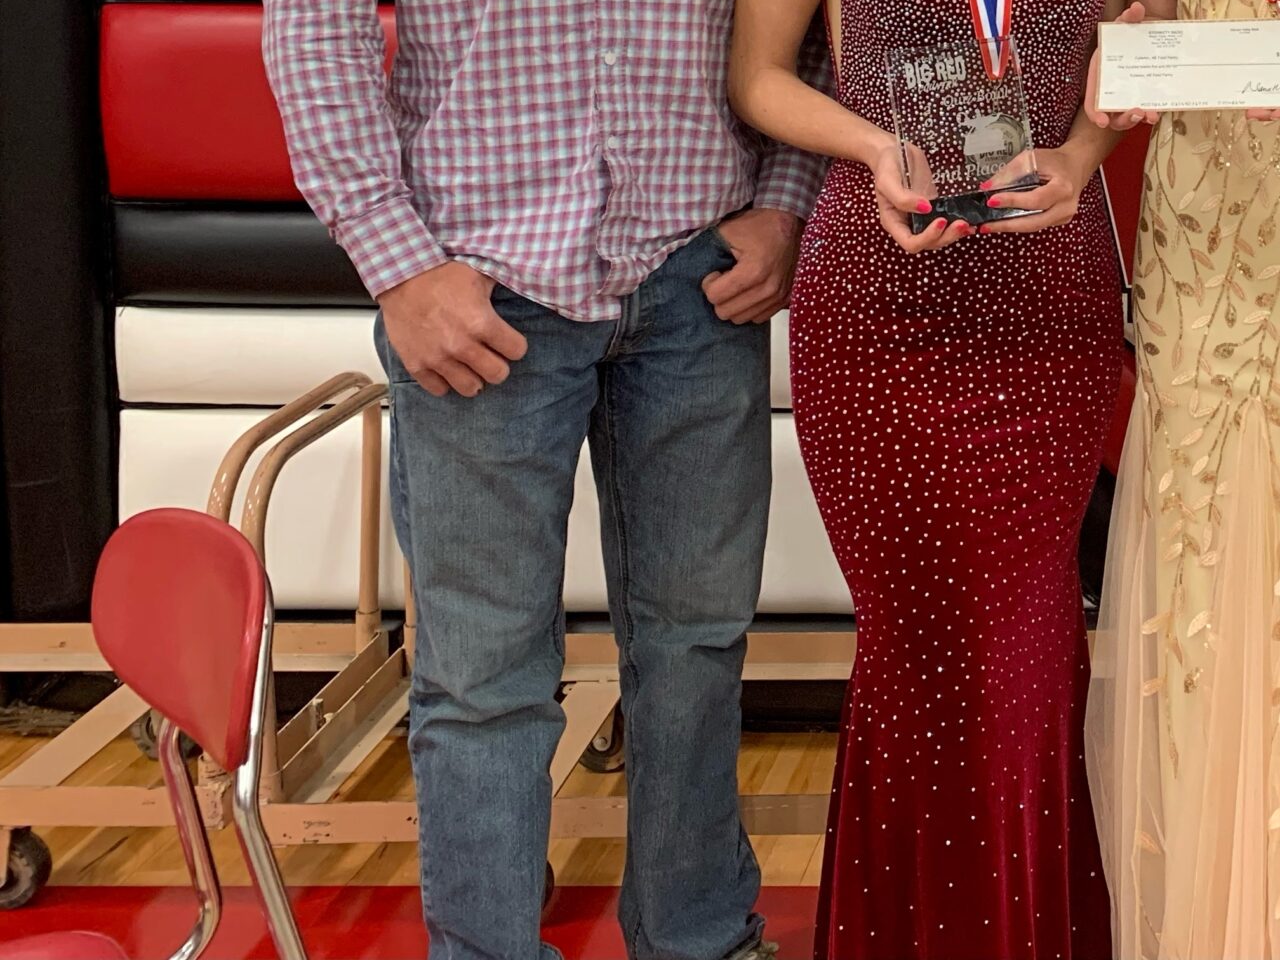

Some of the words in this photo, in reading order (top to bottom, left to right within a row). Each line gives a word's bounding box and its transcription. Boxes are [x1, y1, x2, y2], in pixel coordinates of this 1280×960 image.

[904, 62, 933, 90] BIG
[935, 55, 967, 81] RED
[976, 84, 1009, 103] Bowl
[932, 165, 961, 184] 2nd
